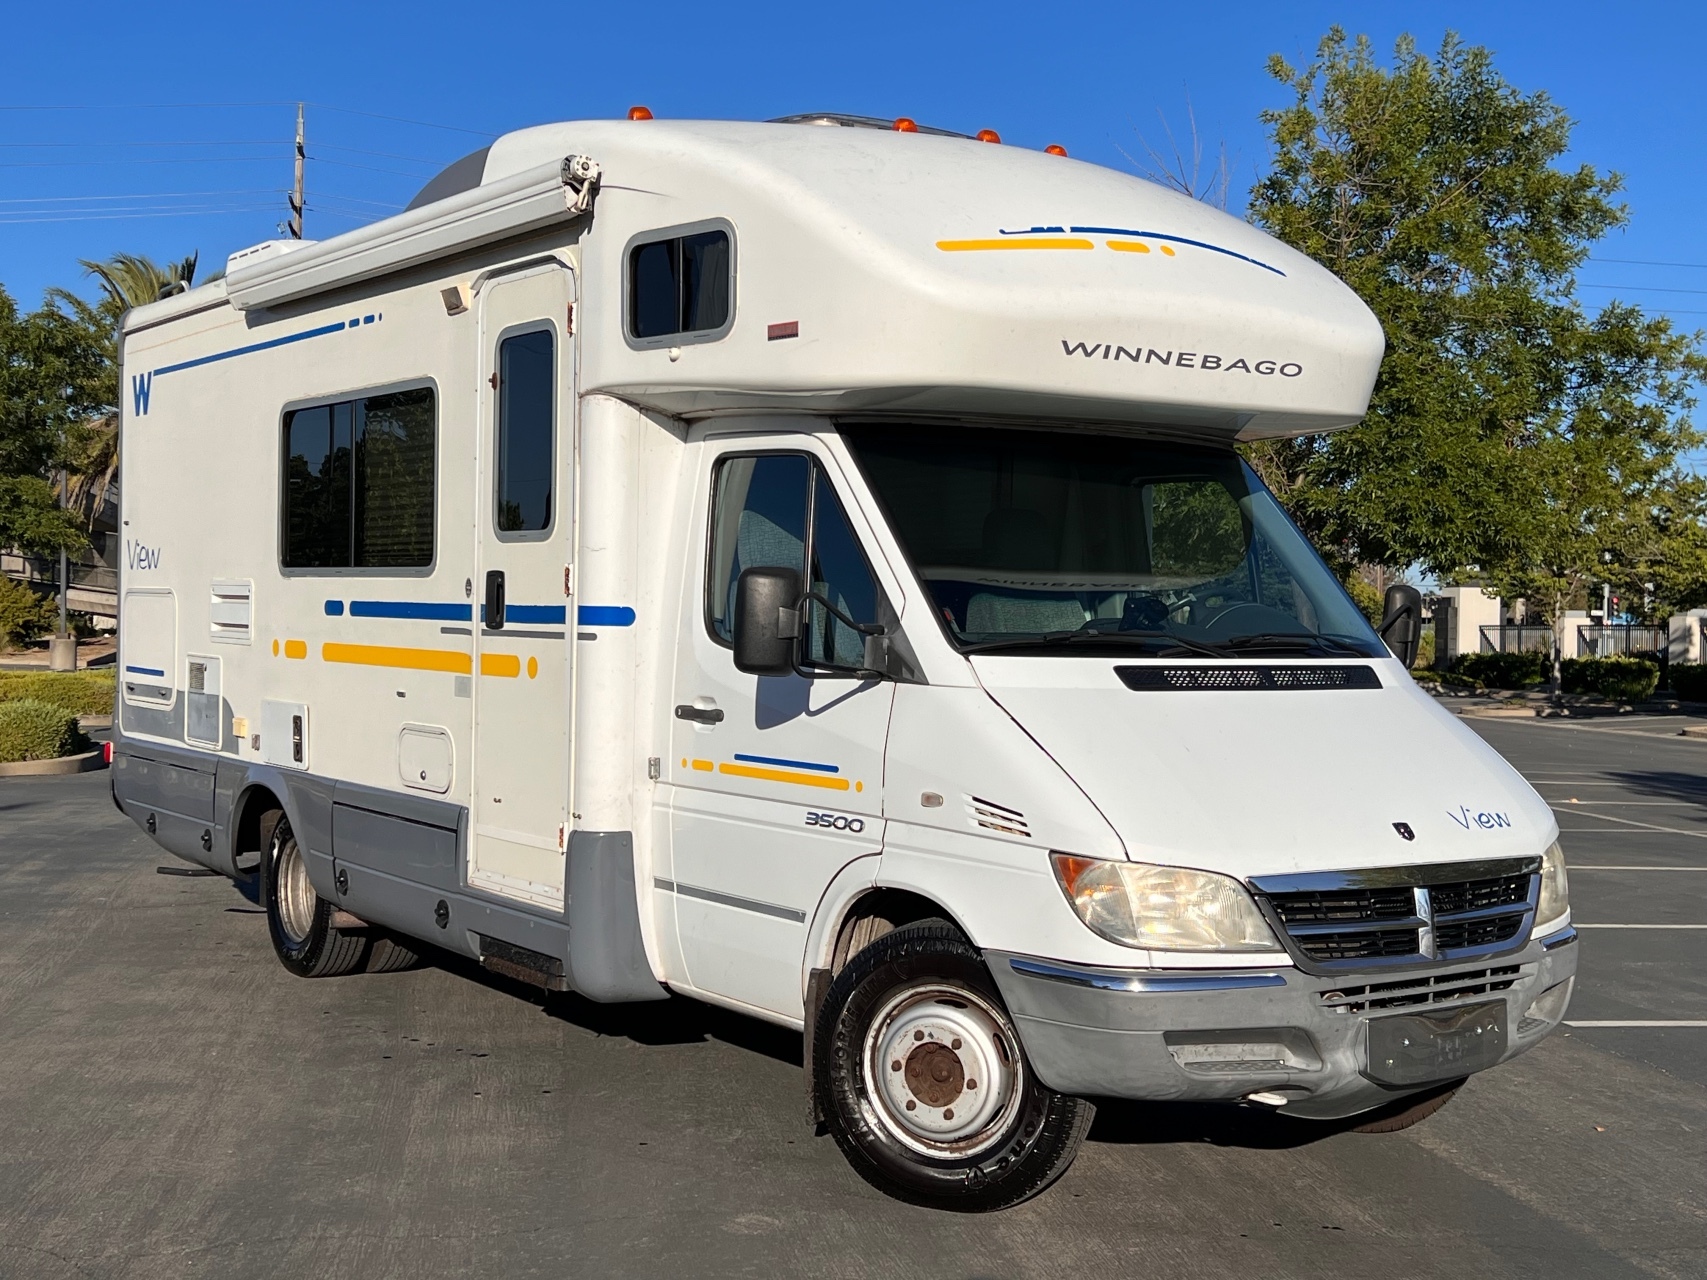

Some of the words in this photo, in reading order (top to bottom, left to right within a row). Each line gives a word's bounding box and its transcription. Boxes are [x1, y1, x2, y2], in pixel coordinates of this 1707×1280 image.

[1061, 340, 1303, 377] WINNEBAGO
[132, 371, 152, 417] W
[127, 539, 161, 570] View
[805, 811, 864, 833] 3500
[1445, 804, 1511, 829] View
